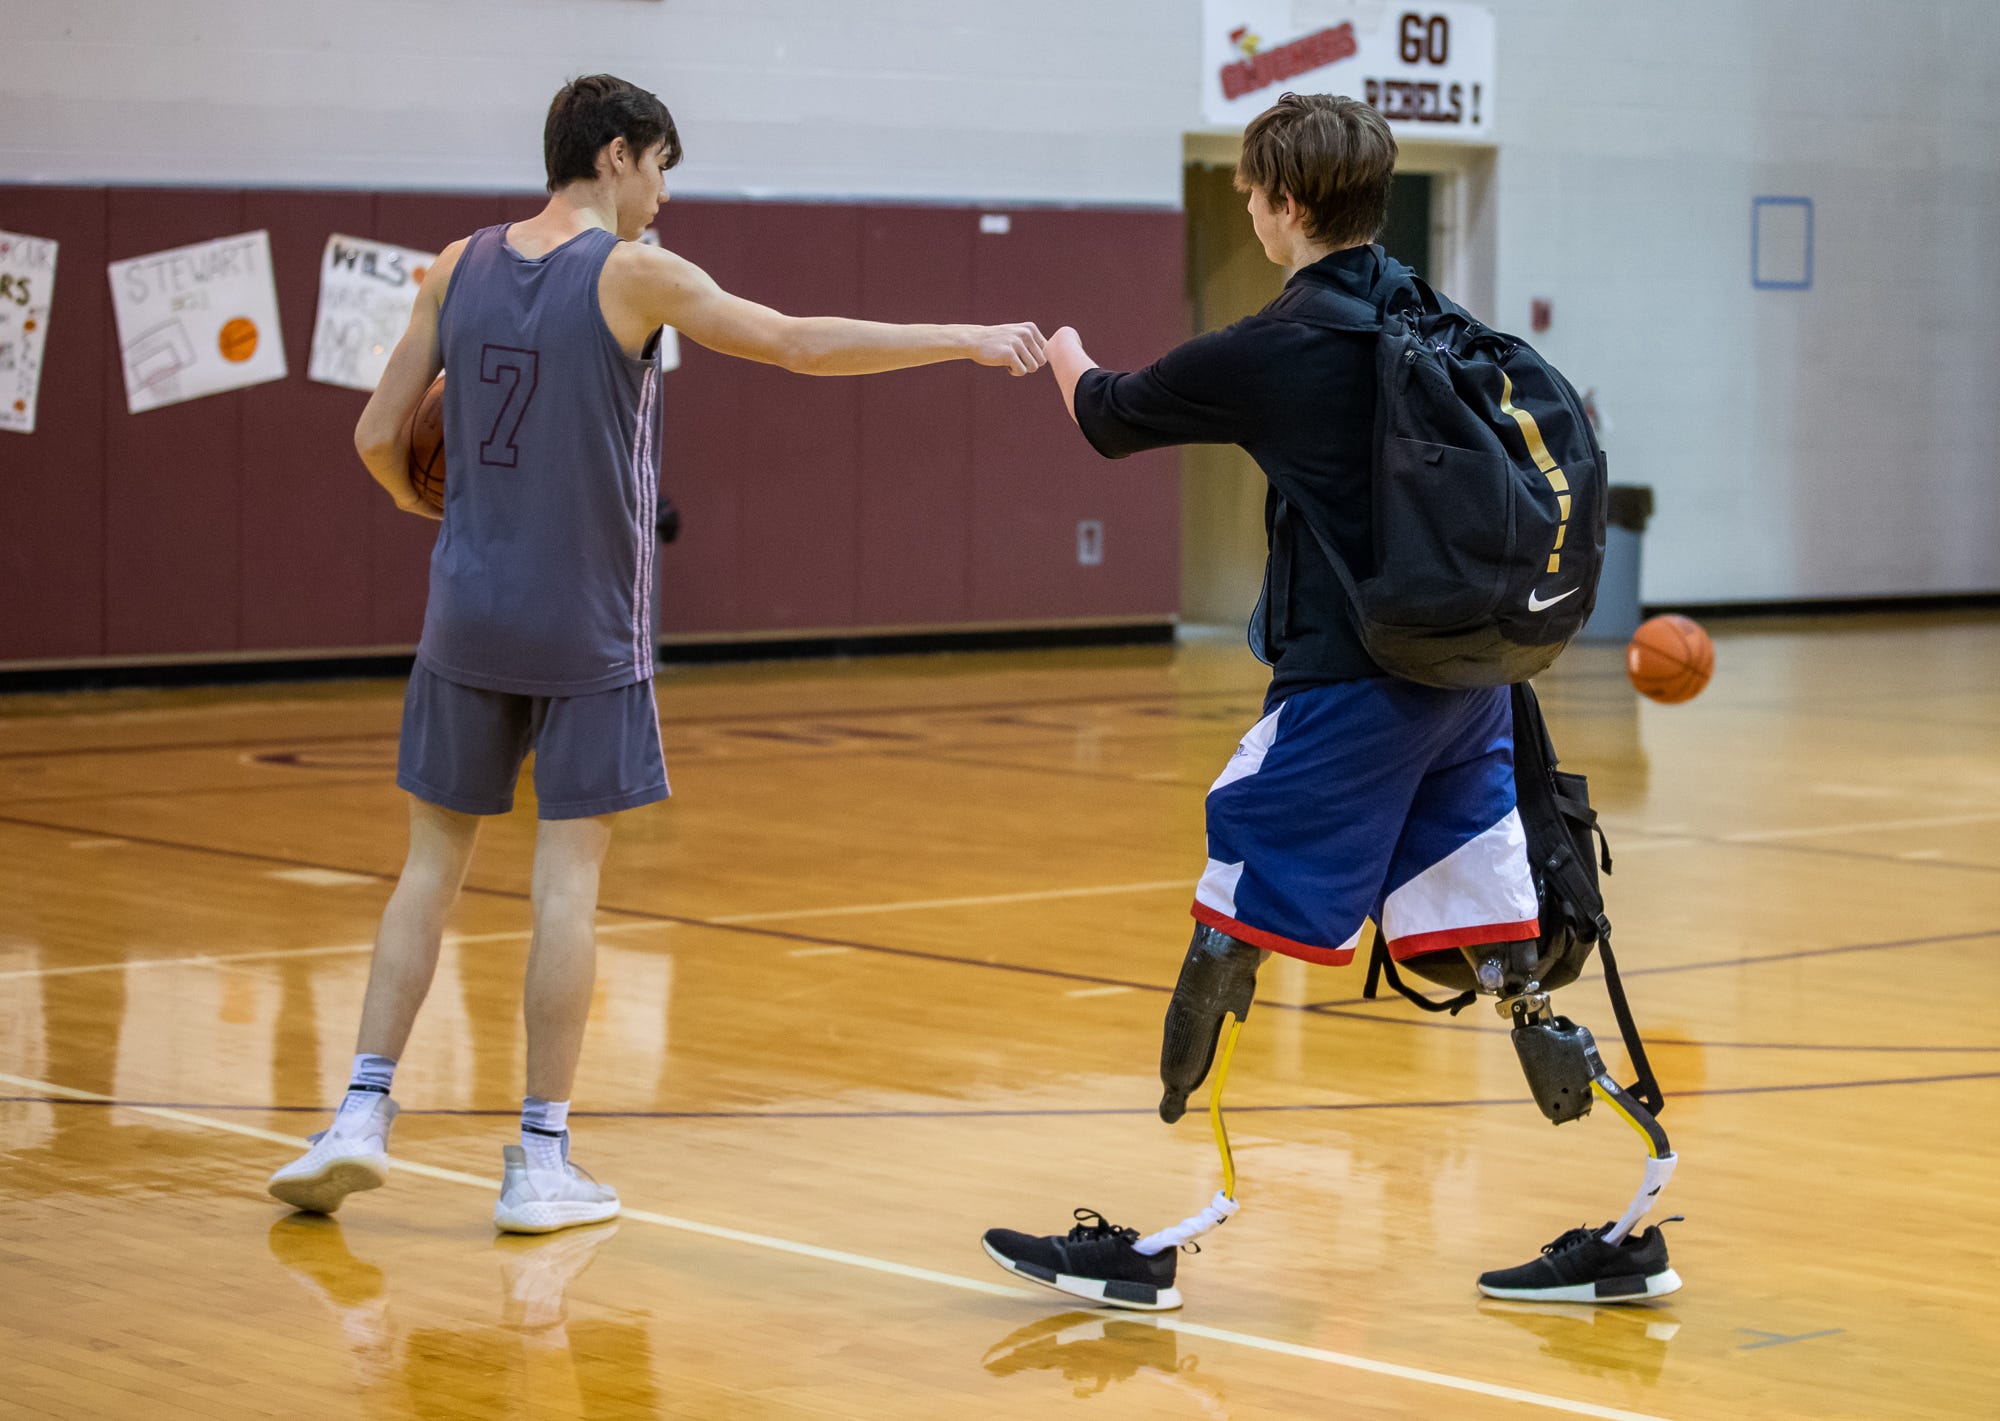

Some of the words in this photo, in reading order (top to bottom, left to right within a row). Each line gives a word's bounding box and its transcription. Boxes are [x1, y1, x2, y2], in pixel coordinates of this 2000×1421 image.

[1400, 12, 1449, 65] GO
[124, 239, 258, 305] STEWART
[480, 343, 540, 468] 7
